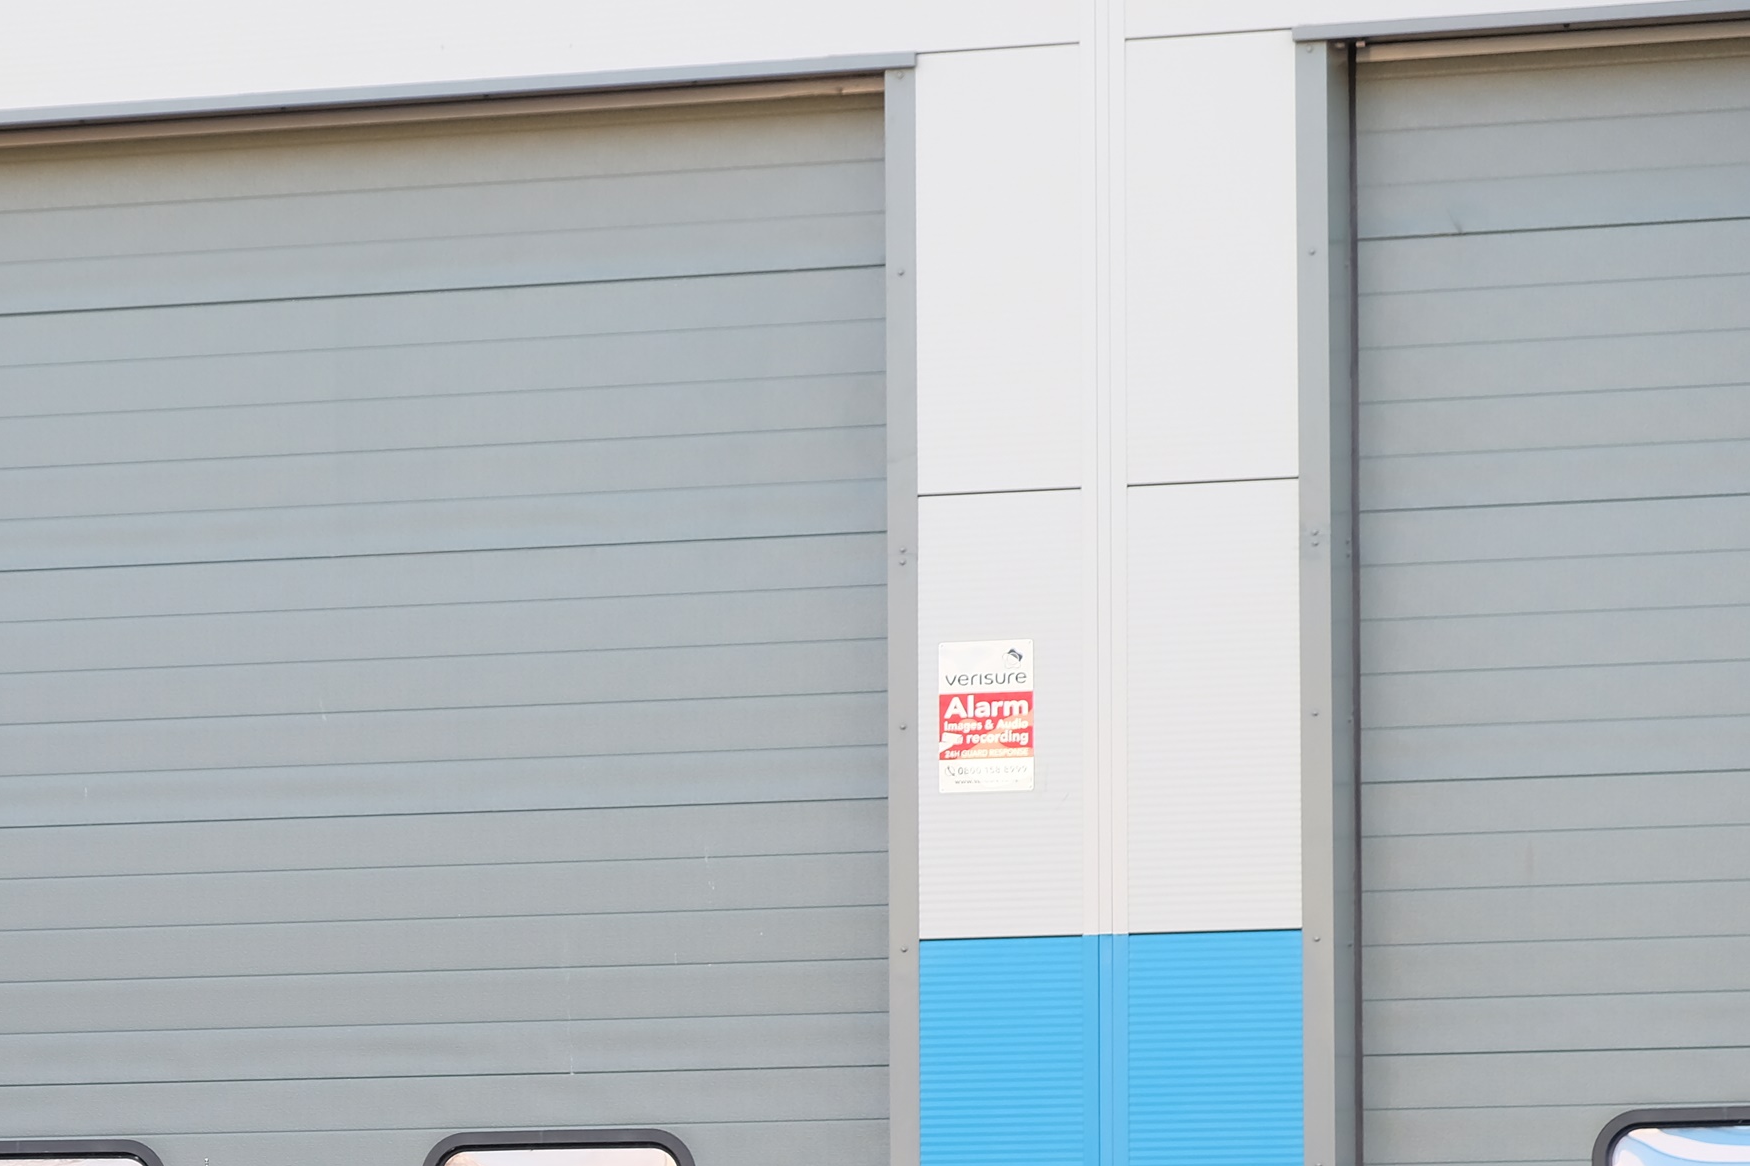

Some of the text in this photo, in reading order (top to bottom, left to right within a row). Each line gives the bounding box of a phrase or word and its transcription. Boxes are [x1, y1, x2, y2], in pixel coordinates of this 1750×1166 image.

[945, 672, 1027, 686] verisure
[944, 695, 1029, 719] Alarm
[944, 717, 1029, 733] Images & Audio
[966, 729, 1029, 746] recording
